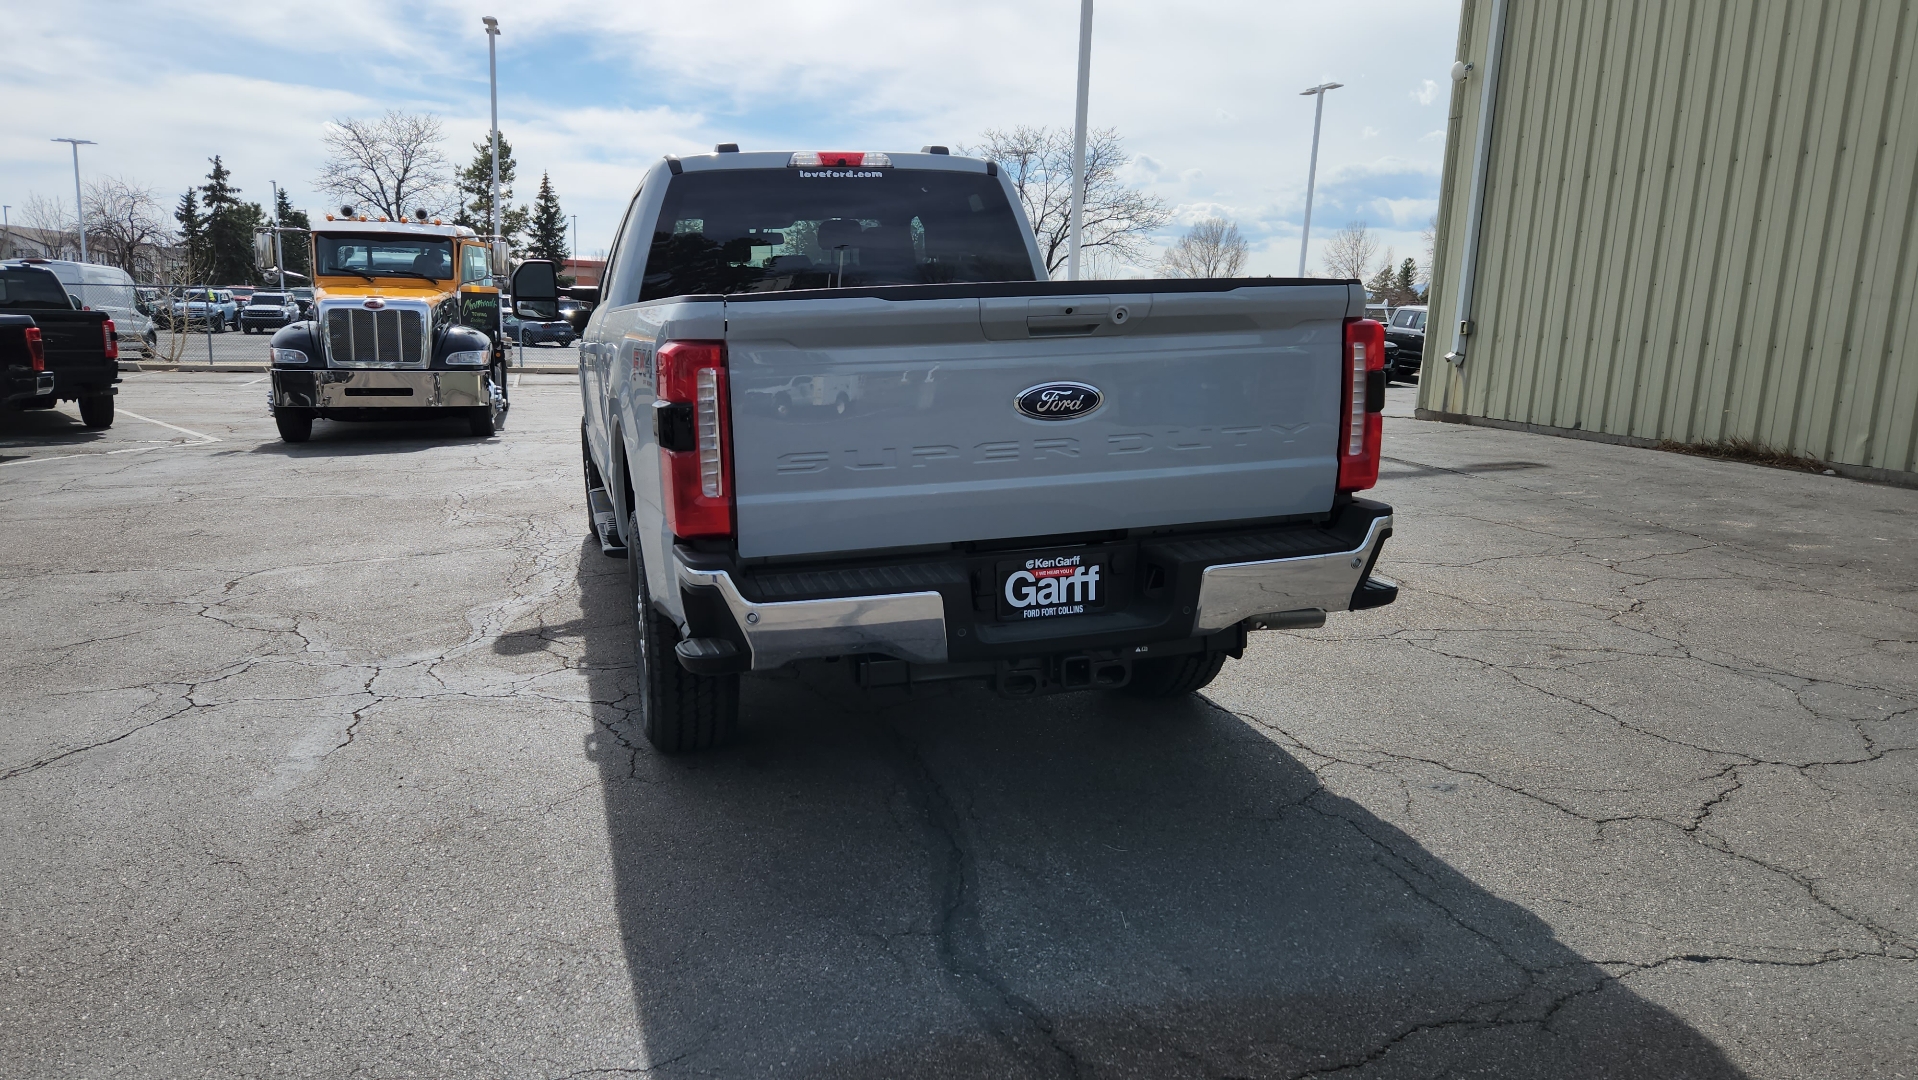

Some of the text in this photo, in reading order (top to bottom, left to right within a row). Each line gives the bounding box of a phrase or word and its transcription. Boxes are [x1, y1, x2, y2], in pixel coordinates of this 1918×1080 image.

[799, 169, 883, 178] loveford.com
[1036, 389, 1085, 412] Ford
[776, 422, 1310, 476] SUPER DUTY
[1035, 555, 1081, 568] Ken Garff
[1005, 565, 1100, 608] Garff
[1023, 604, 1084, 618] FORD FORT COLLINS
